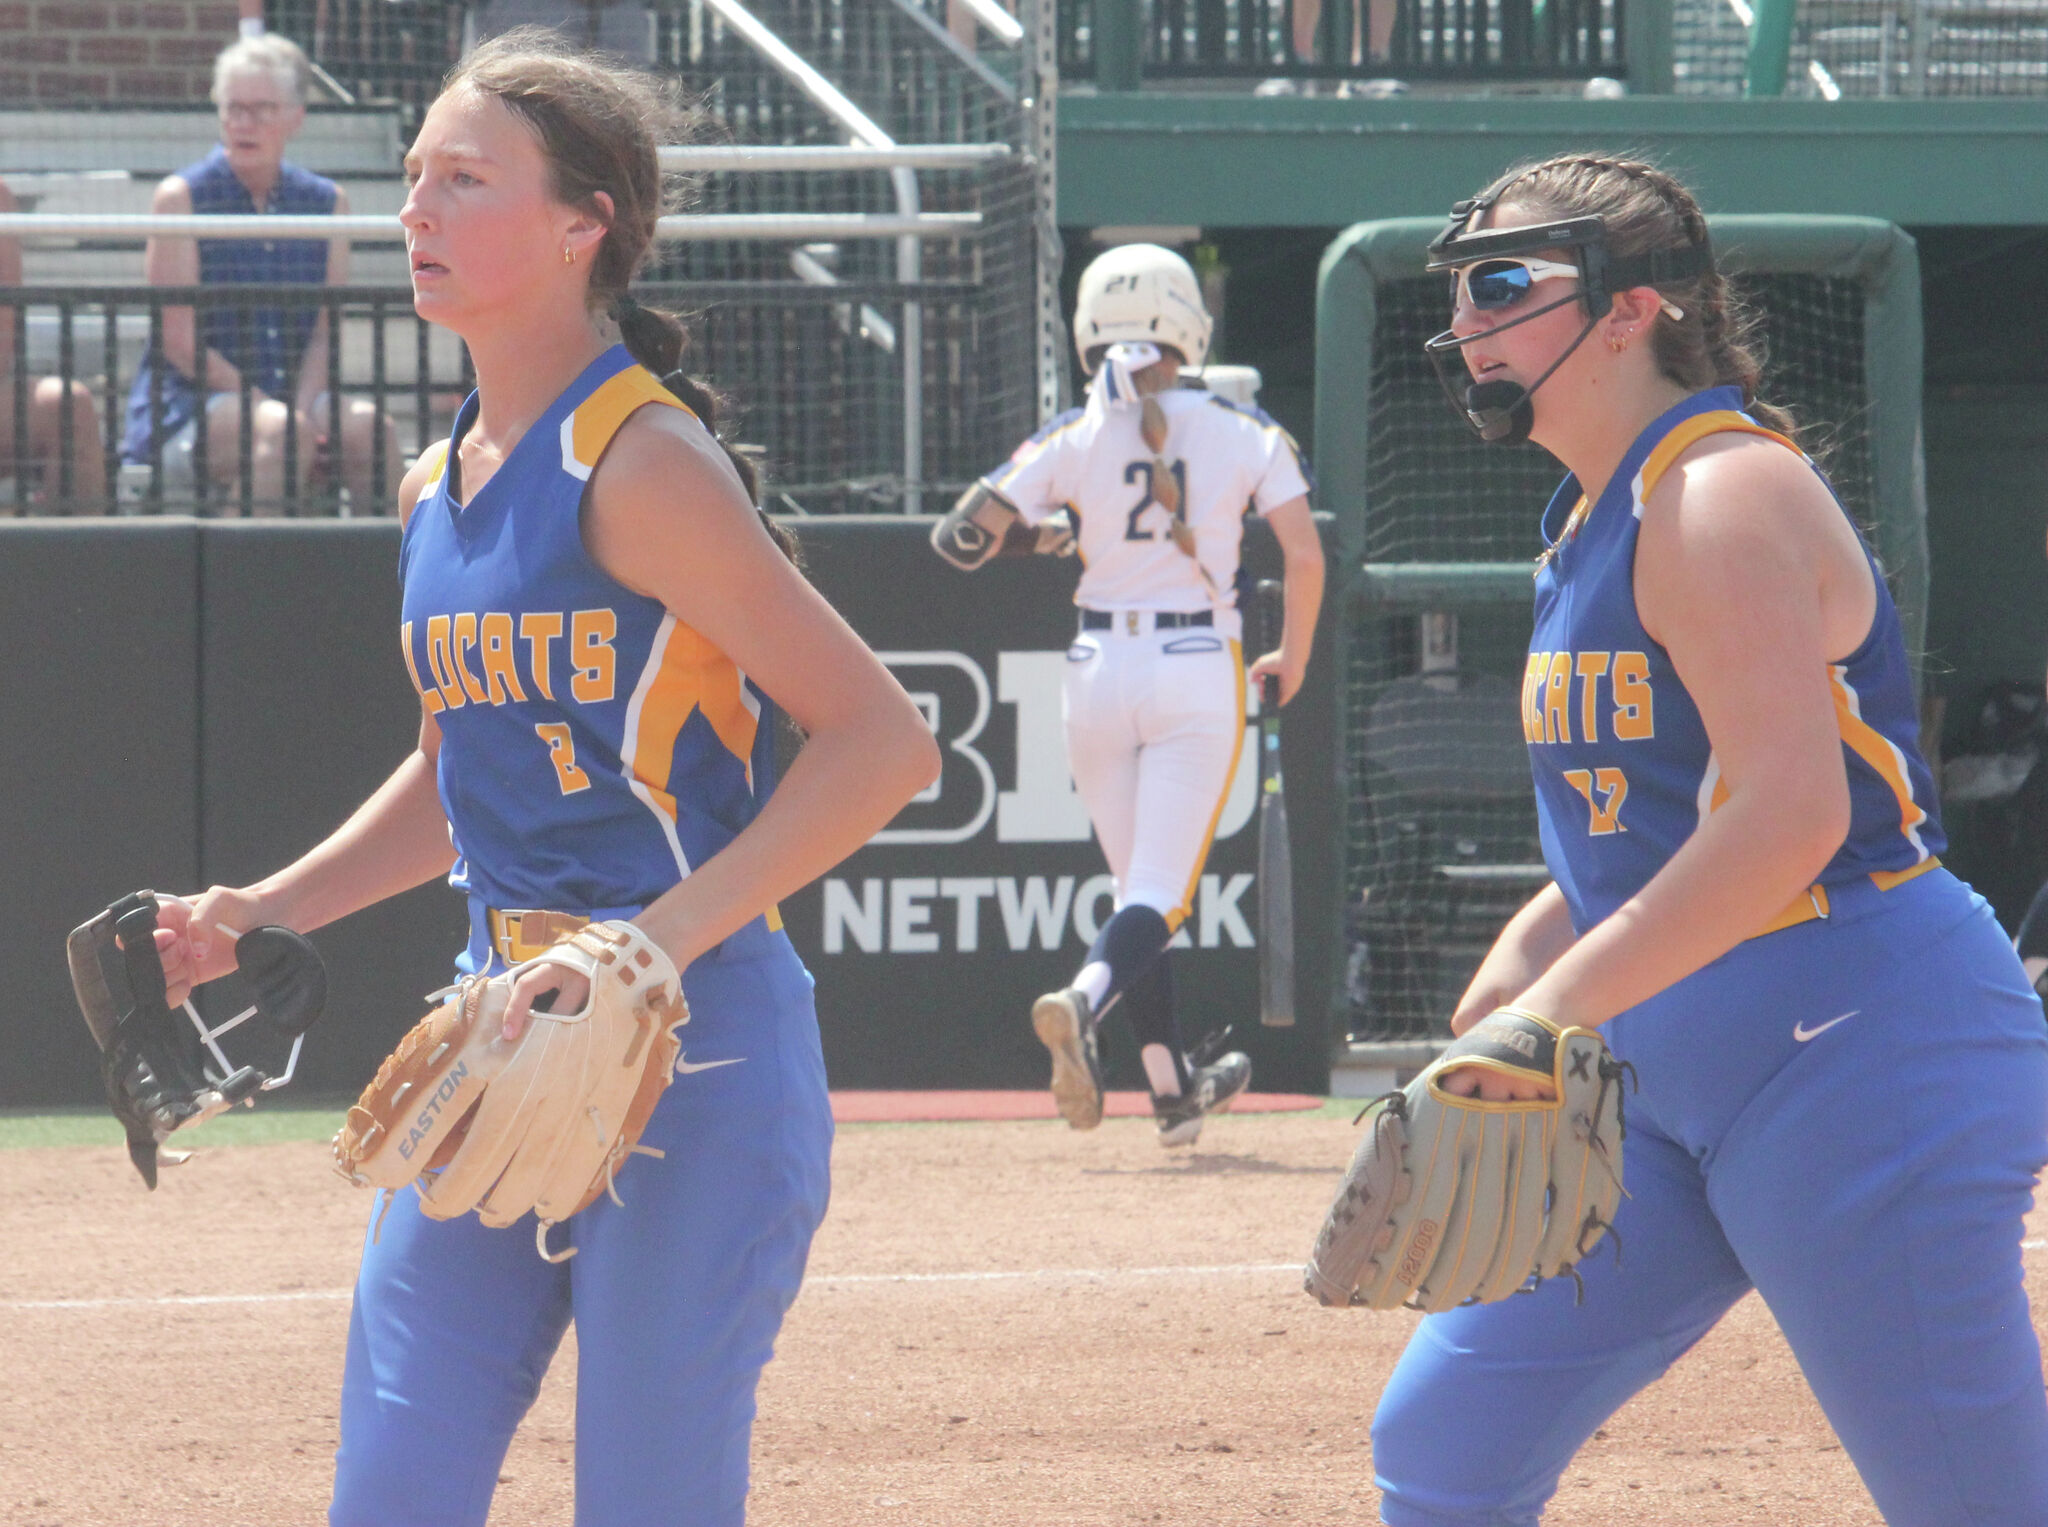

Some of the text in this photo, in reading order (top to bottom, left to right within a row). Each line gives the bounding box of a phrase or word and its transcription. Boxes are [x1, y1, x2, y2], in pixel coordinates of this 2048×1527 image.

[1123, 459, 1186, 541] 21
[401, 608, 617, 715] LDCATS
[535, 722, 592, 796] 2
[823, 874, 1256, 954] NETWOK
[398, 1060, 469, 1160] EASTON
